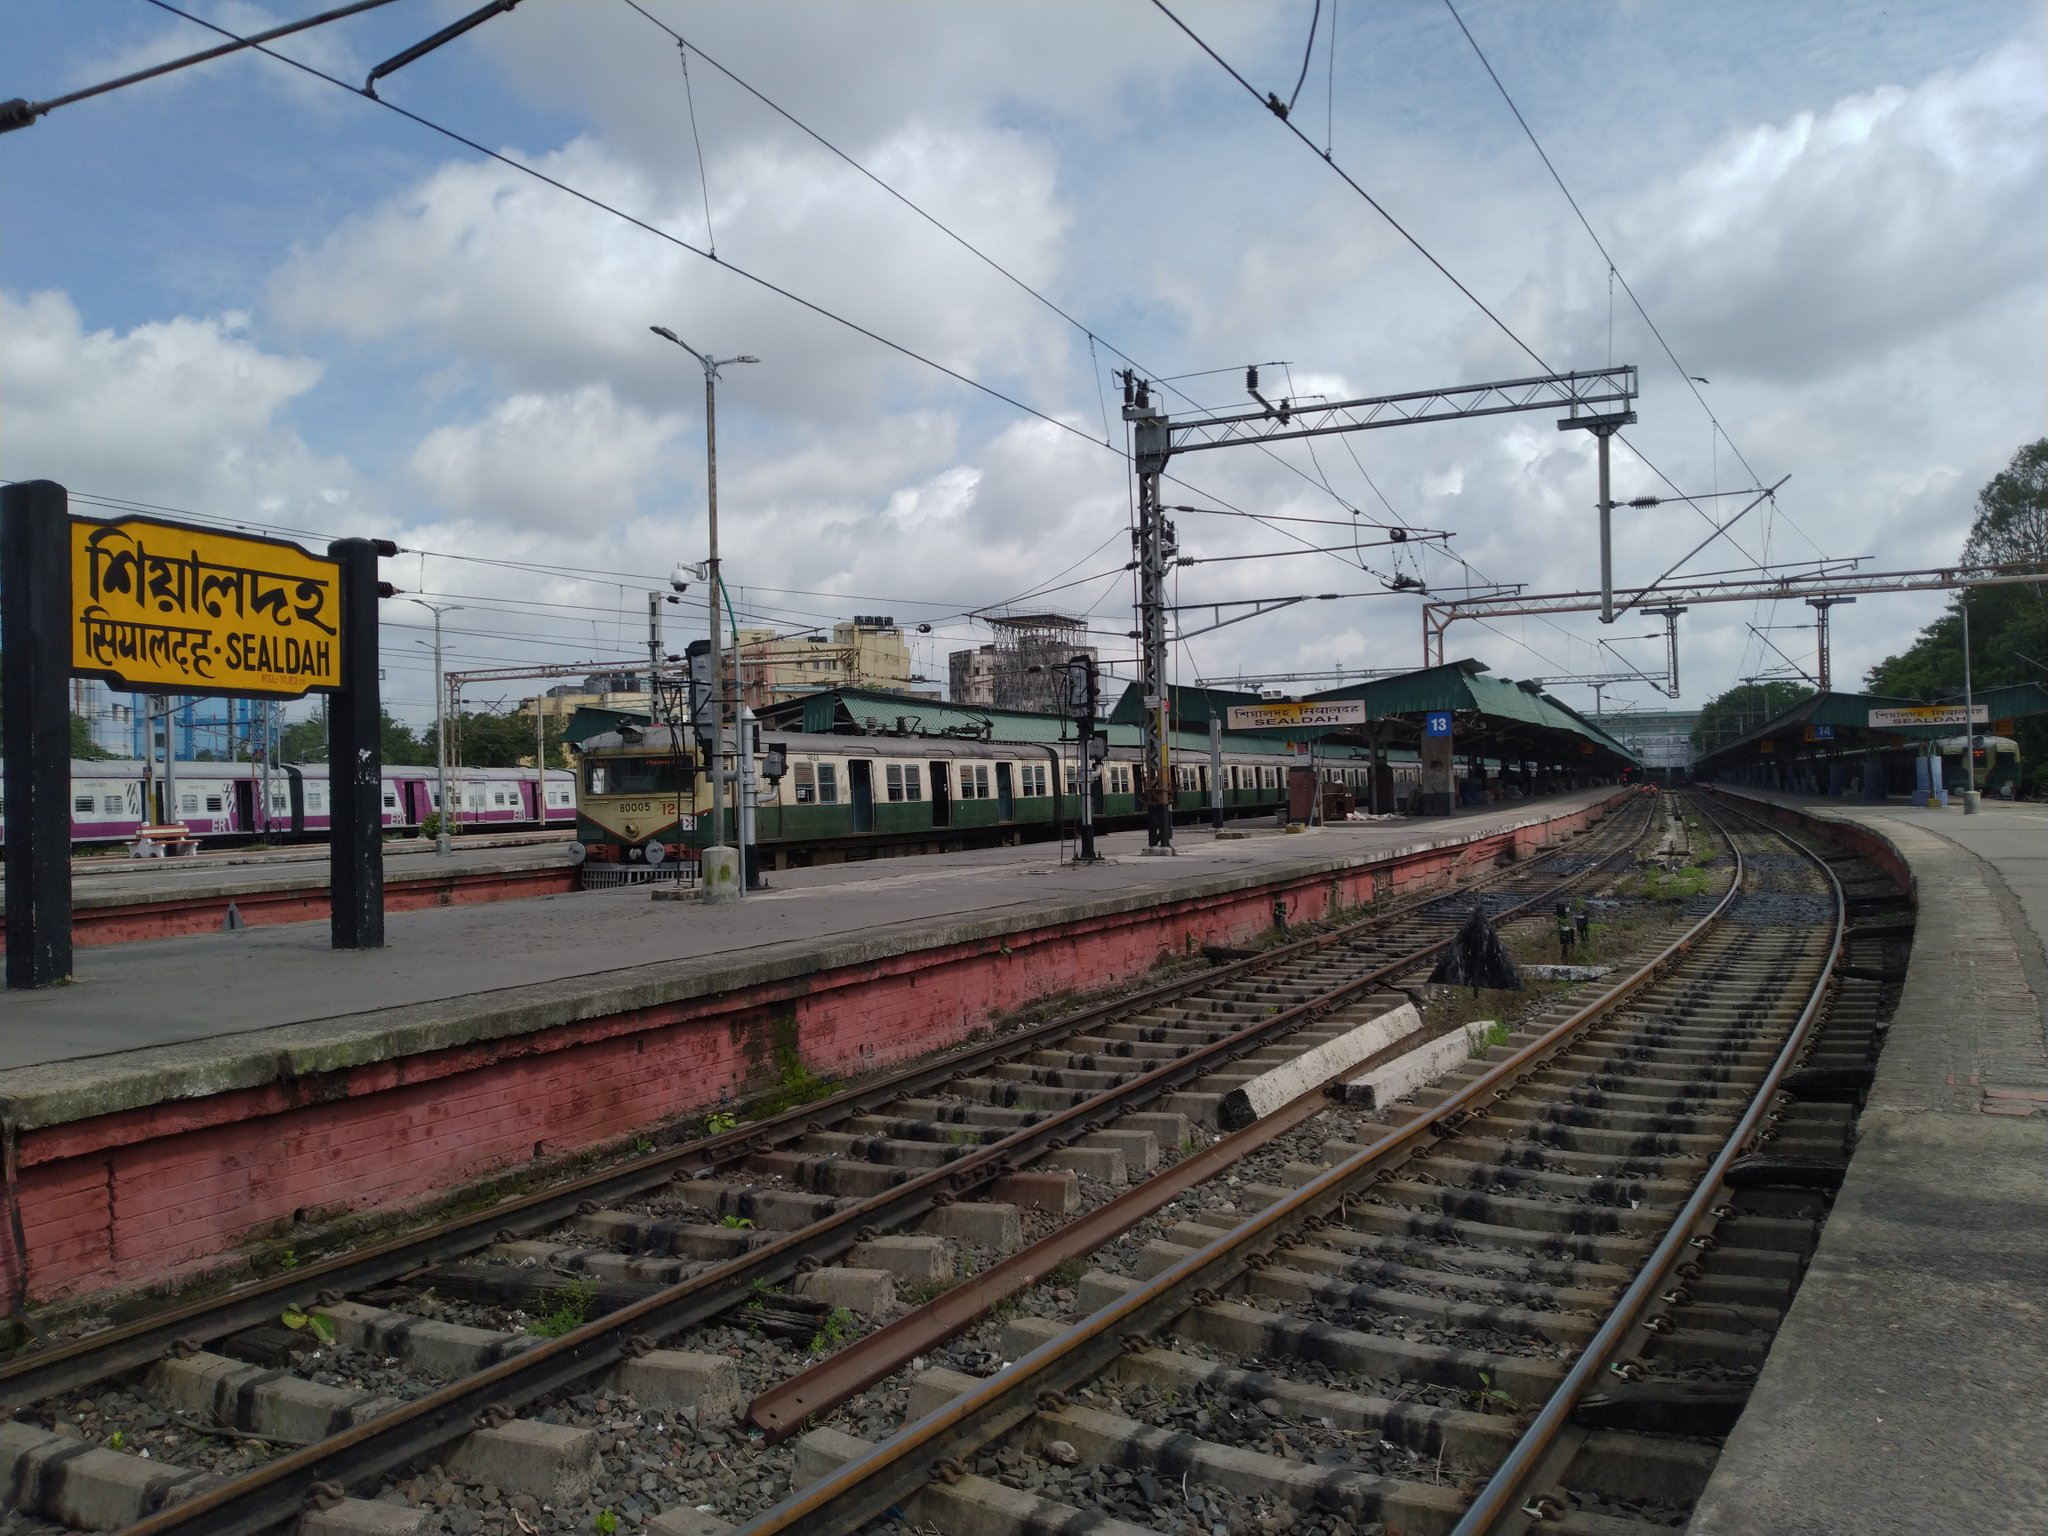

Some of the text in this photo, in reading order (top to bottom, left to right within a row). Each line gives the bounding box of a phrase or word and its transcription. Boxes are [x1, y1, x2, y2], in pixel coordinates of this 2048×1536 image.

[85, 528, 337, 636] শিয়ালদহ
[225, 632, 330, 677] SEALDAH
[1254, 715, 1339, 726] SEALDAH
[1430, 717, 1447, 732] 13
[1892, 716, 1967, 725] SEALDAH
[1817, 726, 1831, 736] 14
[619, 802, 651, 814] 80005
[662, 803, 676, 815] 12
